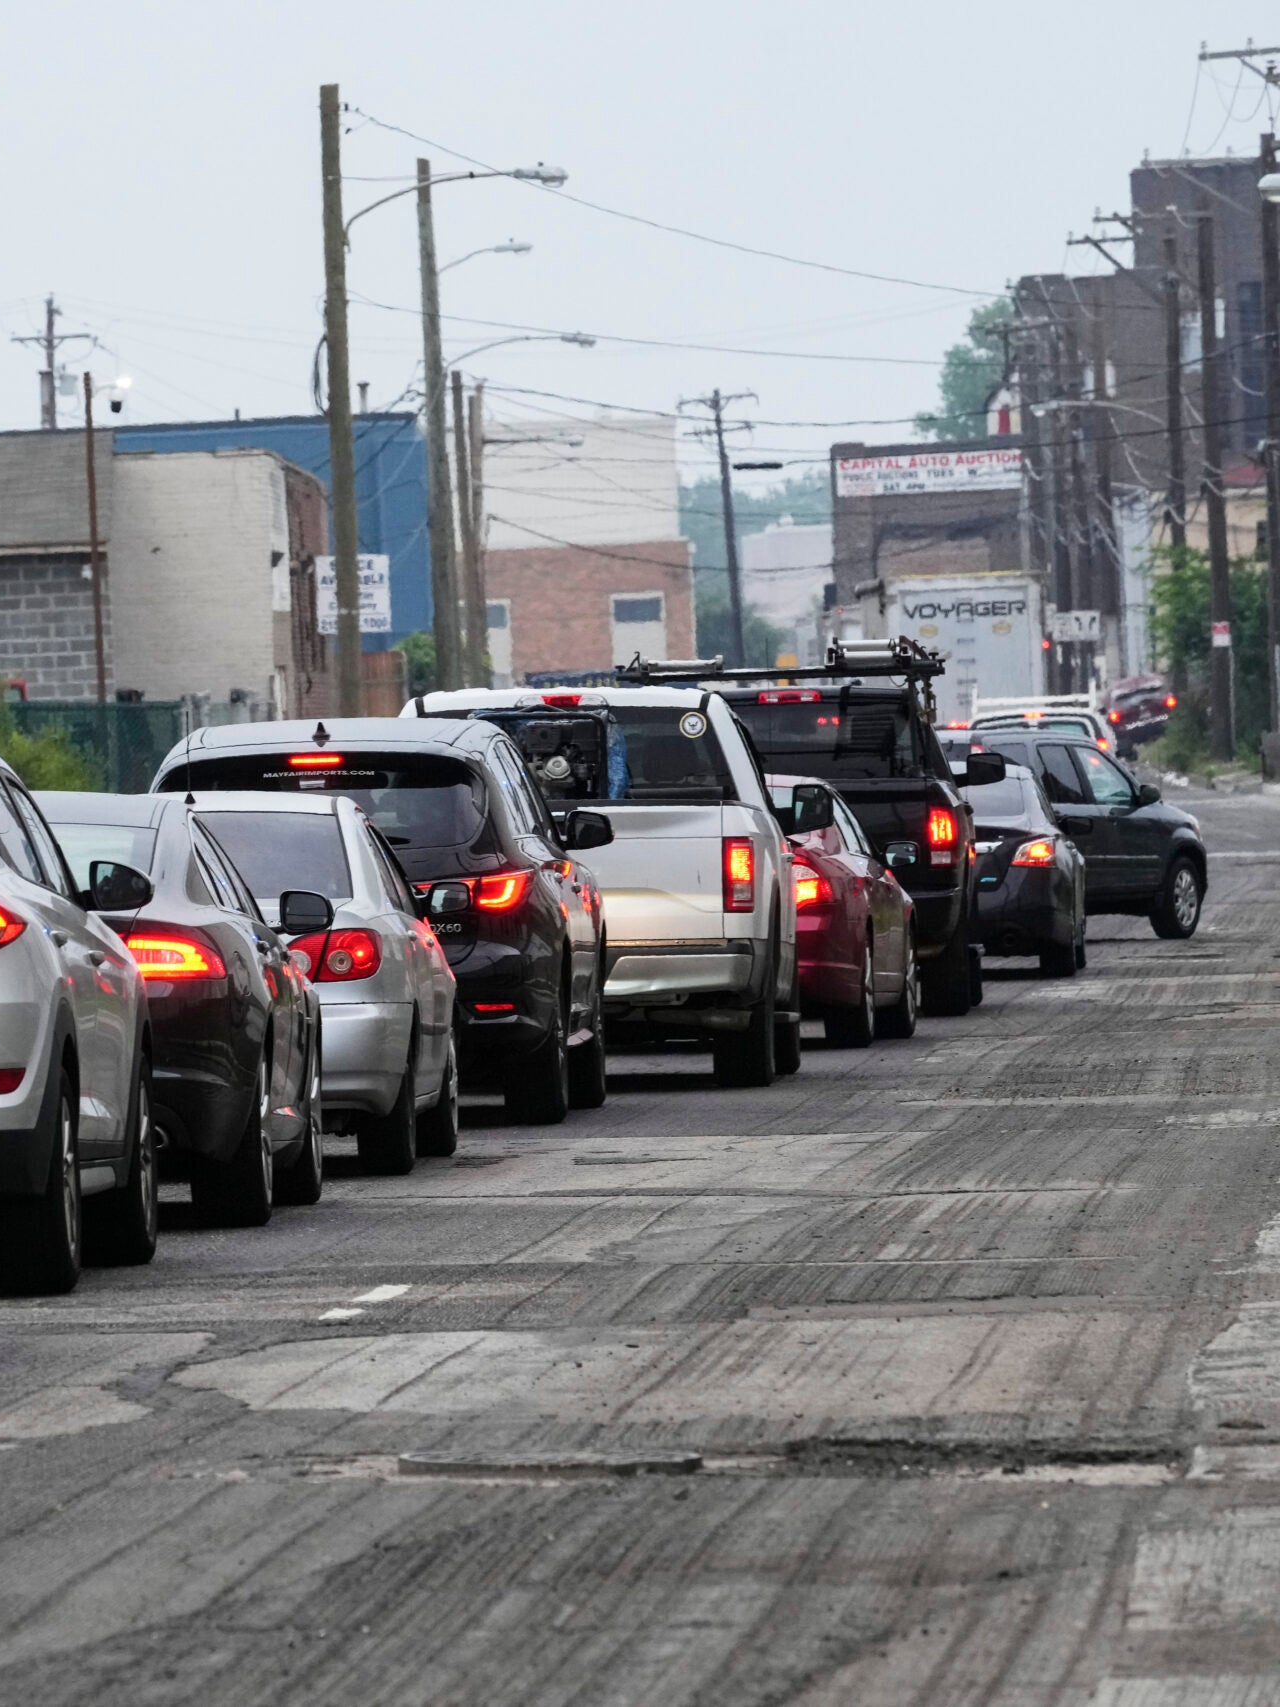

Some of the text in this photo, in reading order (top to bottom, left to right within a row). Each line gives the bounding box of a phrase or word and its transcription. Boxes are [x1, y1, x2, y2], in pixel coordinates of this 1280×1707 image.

[839, 451, 1023, 471] CAPITAL AUTO AUCTION
[903, 600, 1027, 620] VOYAGER
